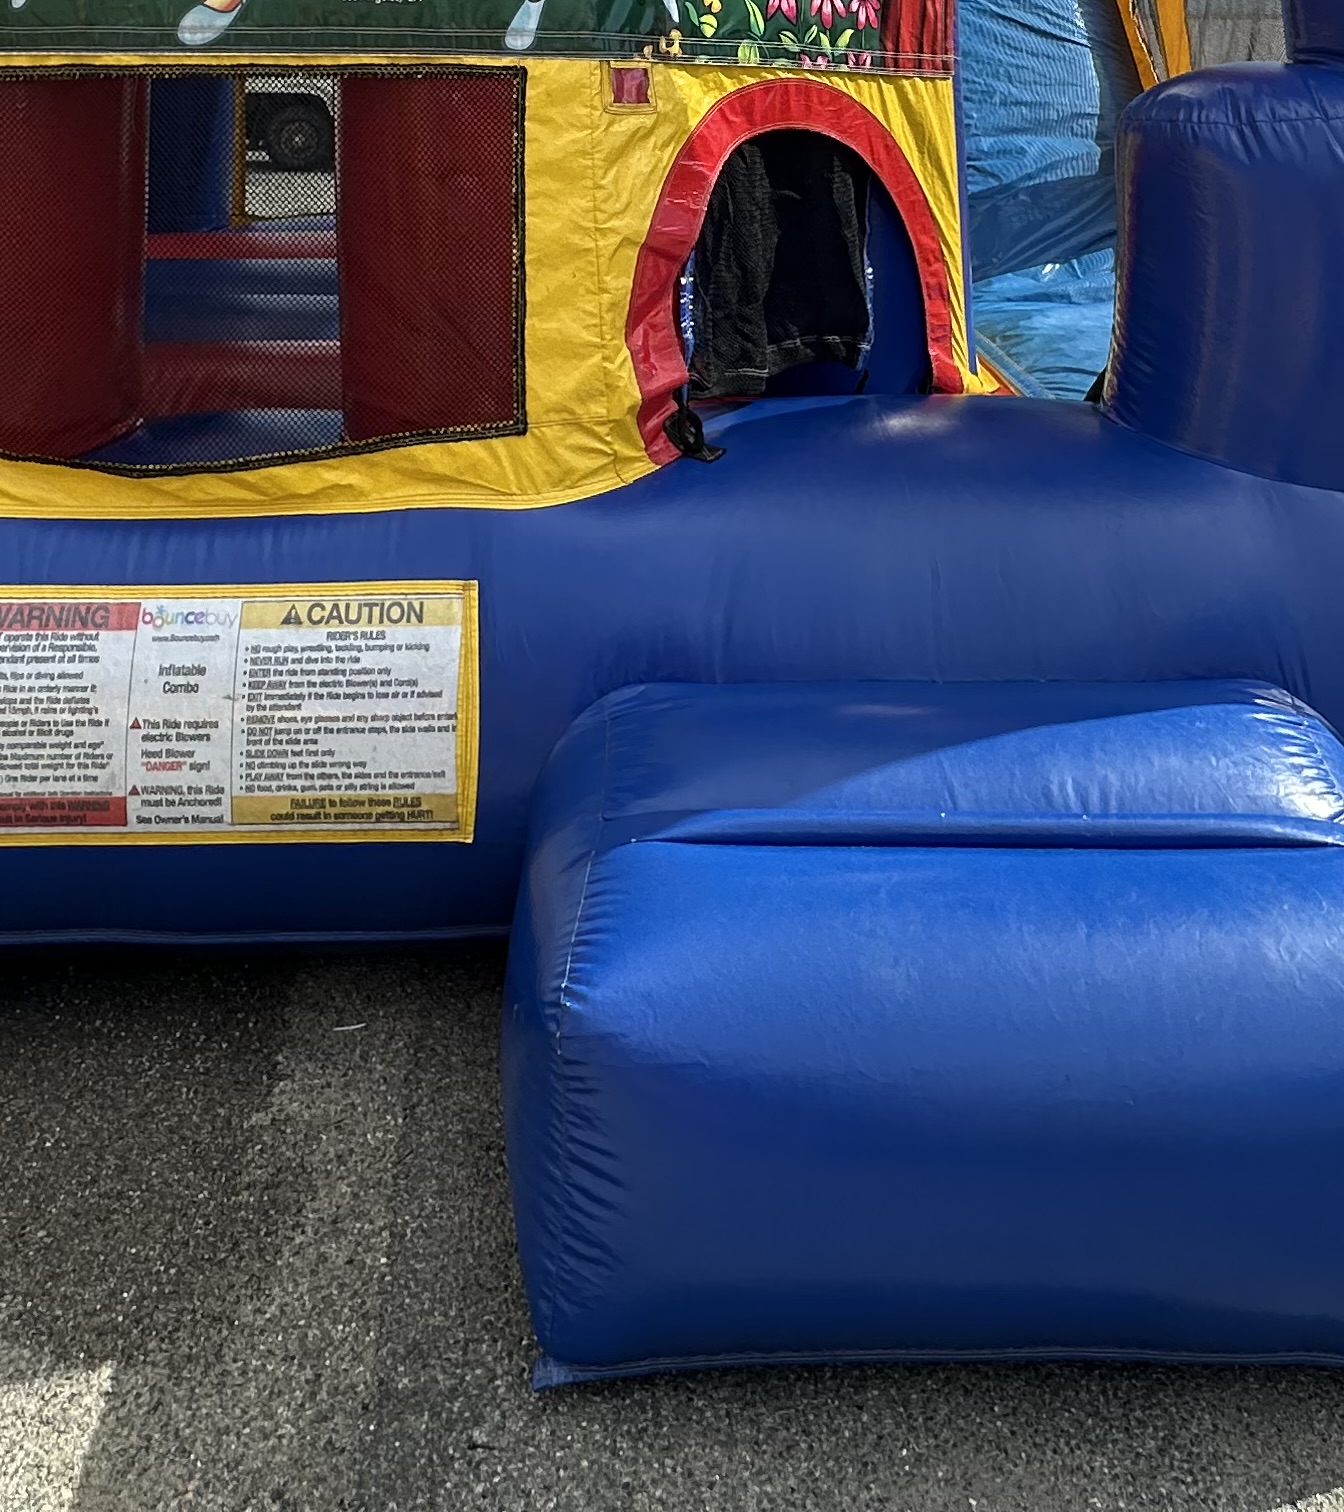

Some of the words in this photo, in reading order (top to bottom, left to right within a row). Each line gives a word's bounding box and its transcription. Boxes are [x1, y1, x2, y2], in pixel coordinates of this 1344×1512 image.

[306, 601, 424, 625] CAUTION
[142, 607, 238, 630] bouncebuy
[158, 664, 207, 676] Inflatable
[162, 681, 199, 694] Combo
[142, 719, 160, 728] This
[162, 719, 181, 728] Ride
[183, 719, 219, 729] requires
[141, 732, 173, 741] electric
[174, 732, 210, 741] Blowers
[164, 749, 195, 757] Blower
[186, 785, 203, 794] this
[204, 785, 224, 794] Ride
[141, 798, 163, 806] must
[136, 815, 152, 823] See
[191, 815, 224, 823] Manual
